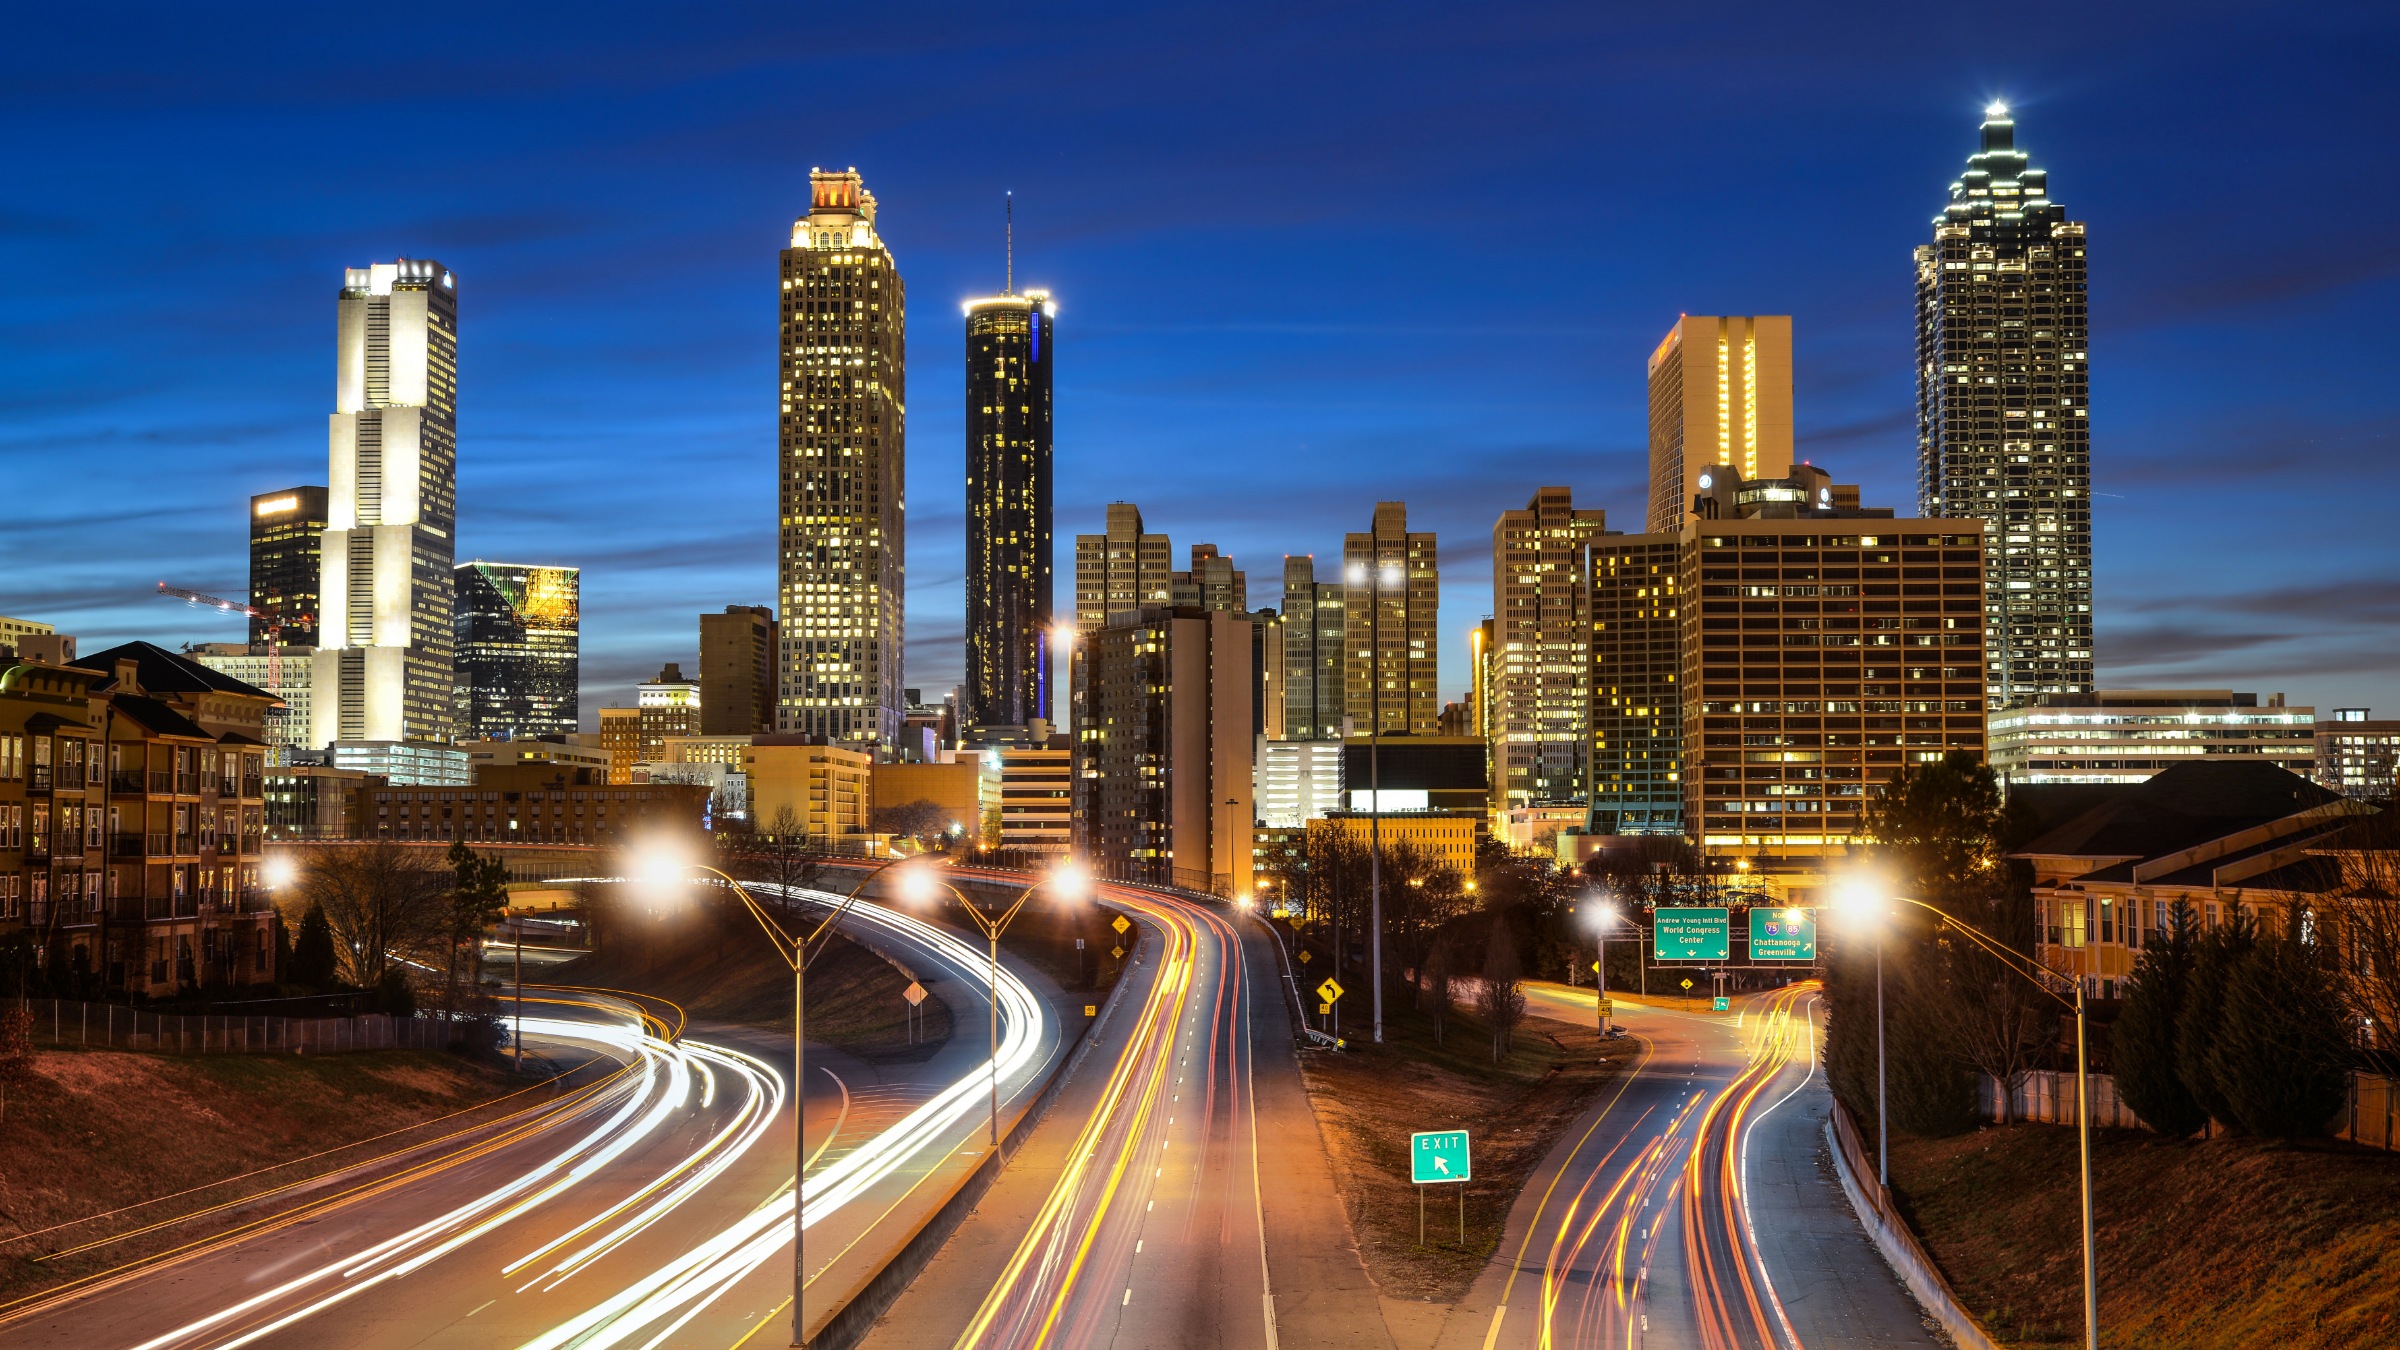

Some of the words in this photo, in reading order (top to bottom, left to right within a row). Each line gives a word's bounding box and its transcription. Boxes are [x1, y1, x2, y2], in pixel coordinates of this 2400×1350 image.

[1686, 926, 1720, 935] Congress
[1754, 939, 1800, 947] Chattanooga
[1422, 1136, 1459, 1150] EXIT
